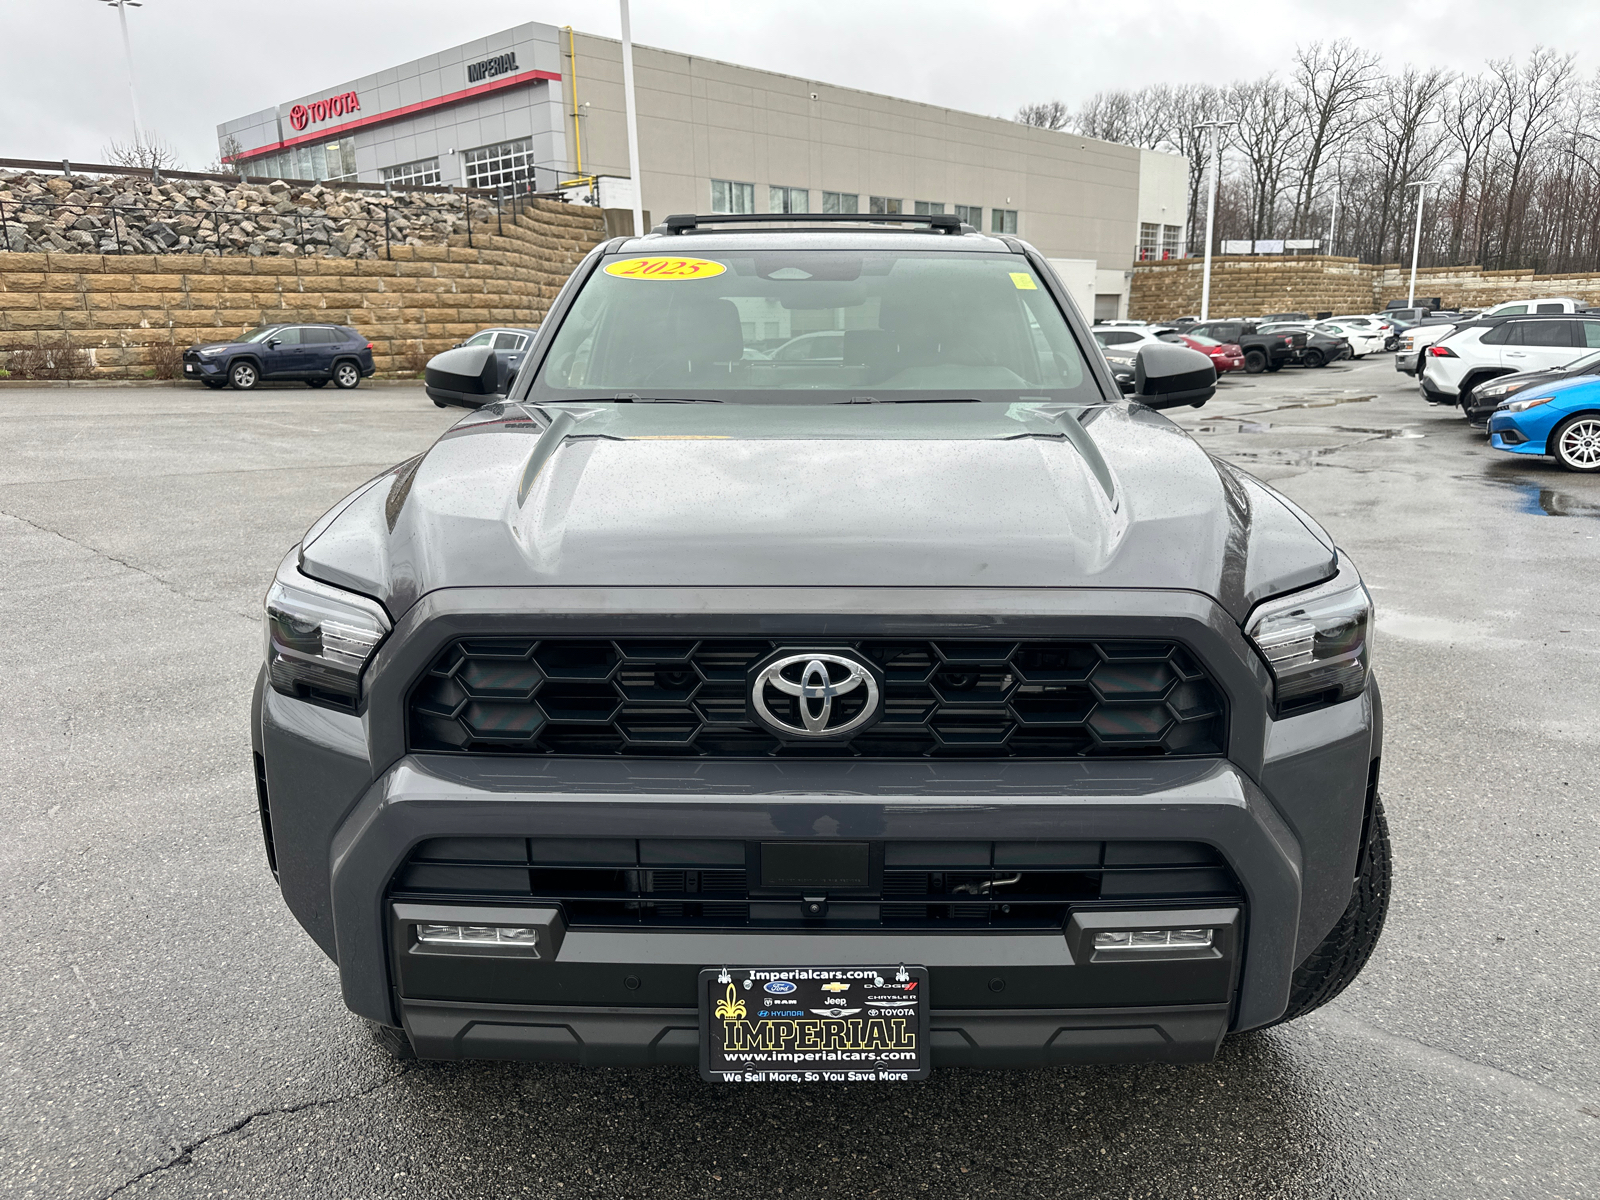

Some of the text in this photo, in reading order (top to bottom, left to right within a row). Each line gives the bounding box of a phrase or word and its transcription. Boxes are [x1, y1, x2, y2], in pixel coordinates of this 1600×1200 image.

[467, 51, 519, 83] IMPERIAL
[307, 91, 360, 123] TOYOTA
[620, 261, 708, 275] 2025
[749, 969, 878, 982] Imperialcars.com
[824, 996, 847, 1006] Jeep
[880, 1008, 915, 1016] TOYOTA
[724, 1019, 915, 1050] IMPERIAL
[724, 1051, 916, 1063] www.imperialcars.com
[723, 1071, 908, 1083] We Sell More, So You Save More
